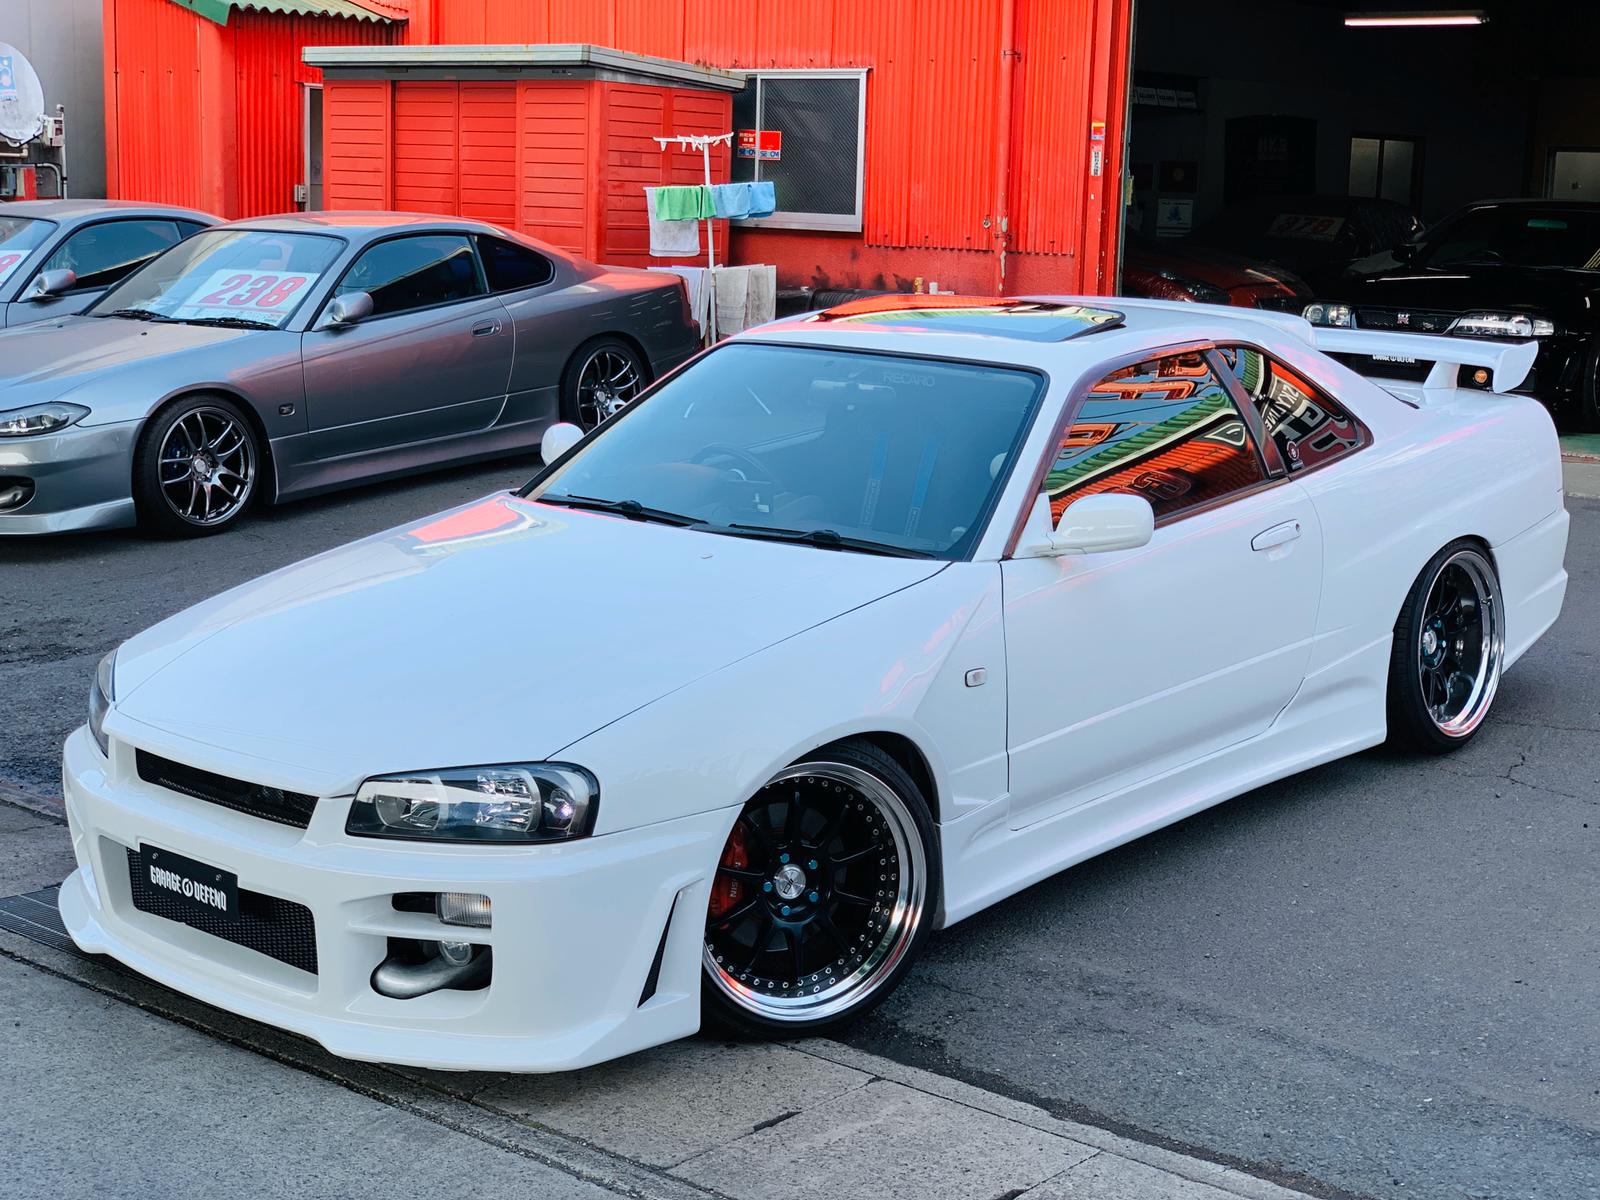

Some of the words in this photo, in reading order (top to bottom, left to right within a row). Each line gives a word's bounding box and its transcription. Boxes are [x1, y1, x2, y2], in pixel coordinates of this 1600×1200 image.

[200, 274, 307, 307] 238
[882, 371, 936, 388] RECARO
[193, 880, 227, 912] DEFEND
